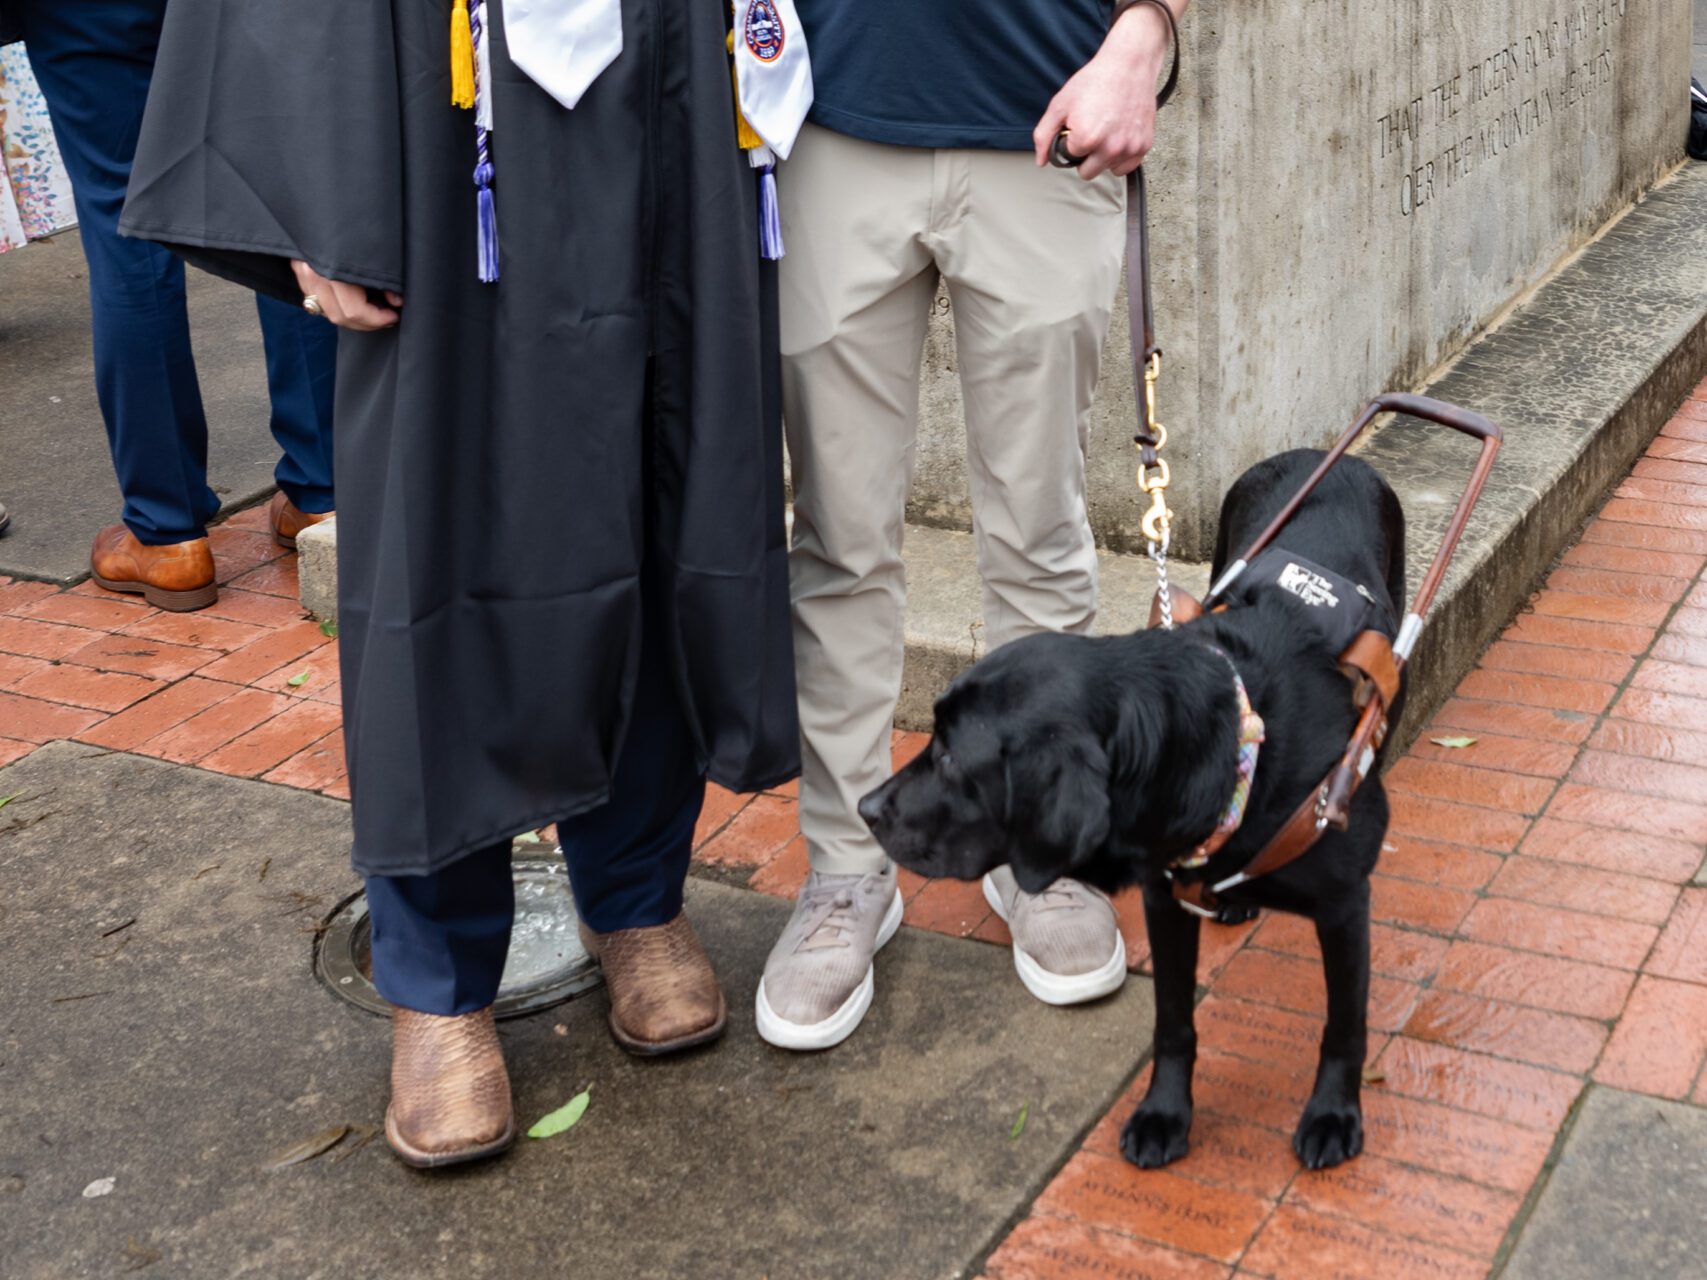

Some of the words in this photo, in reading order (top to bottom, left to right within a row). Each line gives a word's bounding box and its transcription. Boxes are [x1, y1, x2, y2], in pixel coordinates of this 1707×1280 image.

[1377, 97, 1423, 158] THAT
[1432, 75, 1461, 126] THE
[1525, 21, 1560, 73] ROAR
[1444, 135, 1473, 188] THE
[1480, 88, 1553, 161] MOUNTAIN
